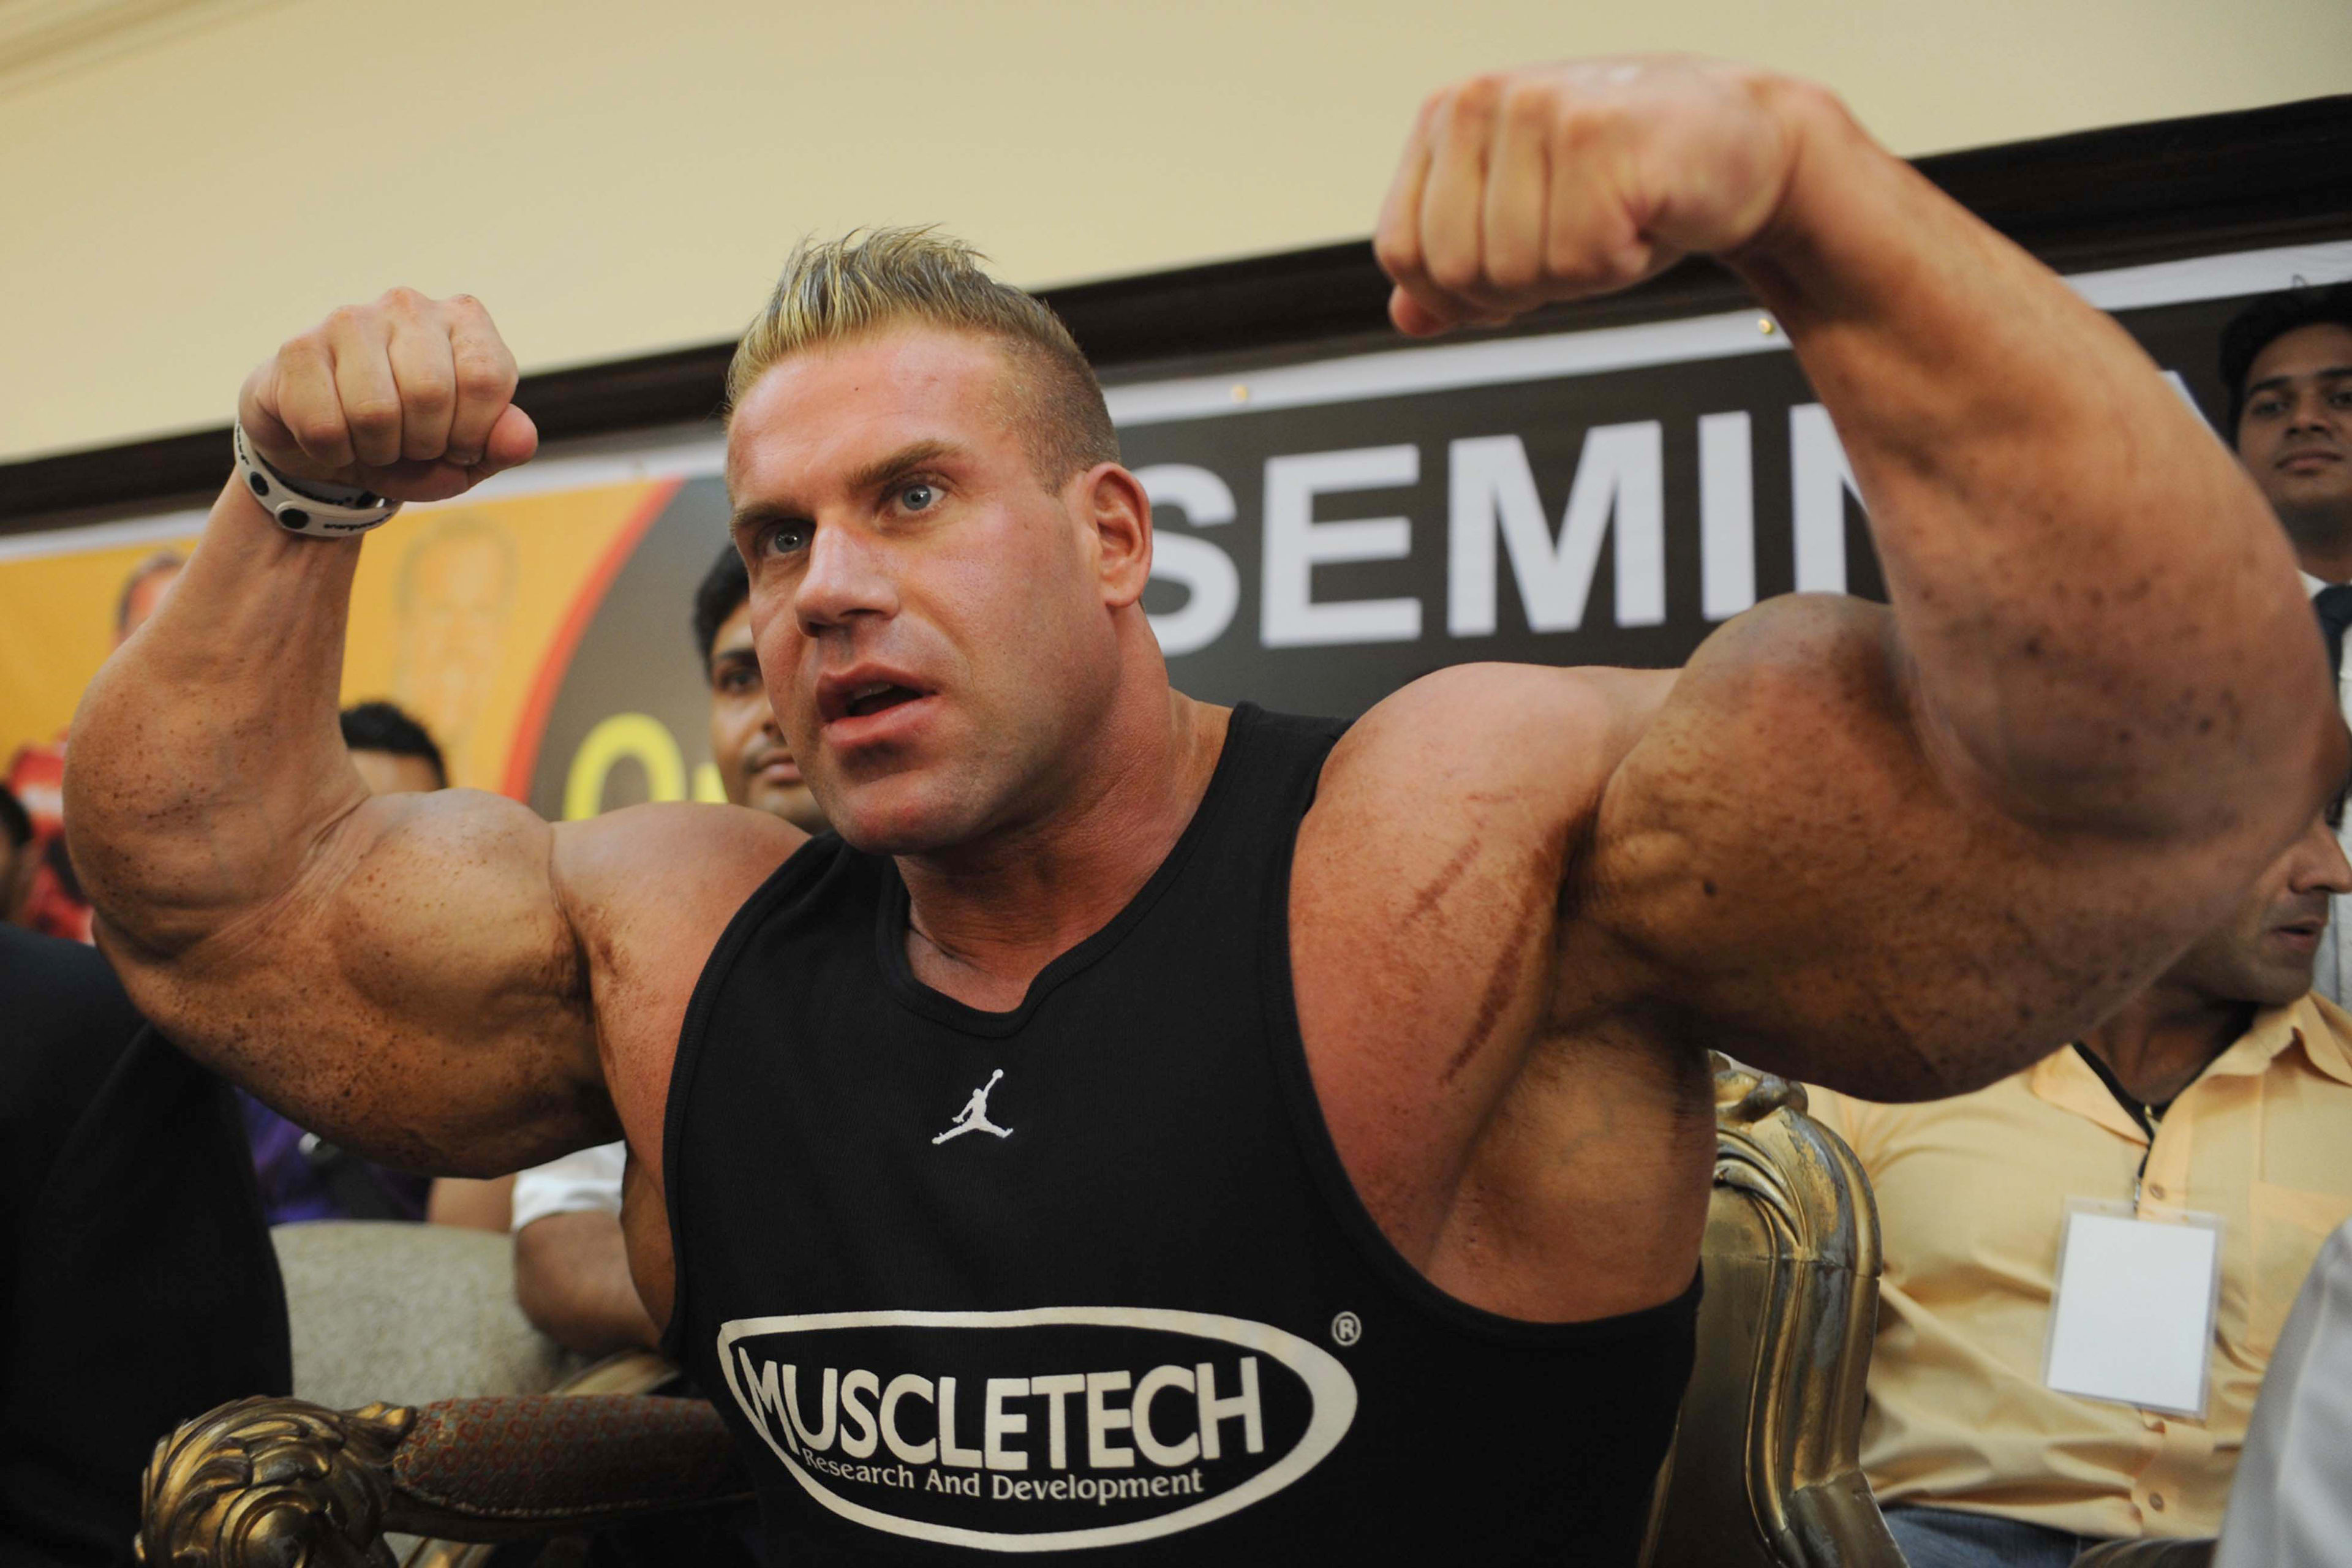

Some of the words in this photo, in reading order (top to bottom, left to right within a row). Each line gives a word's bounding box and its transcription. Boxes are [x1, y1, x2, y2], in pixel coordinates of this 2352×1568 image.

[737, 1346, 1264, 1471] MUSCLETECH
[801, 1447, 914, 1489] Research
[924, 1468, 981, 1498] And
[992, 1468, 1204, 1506] Development
